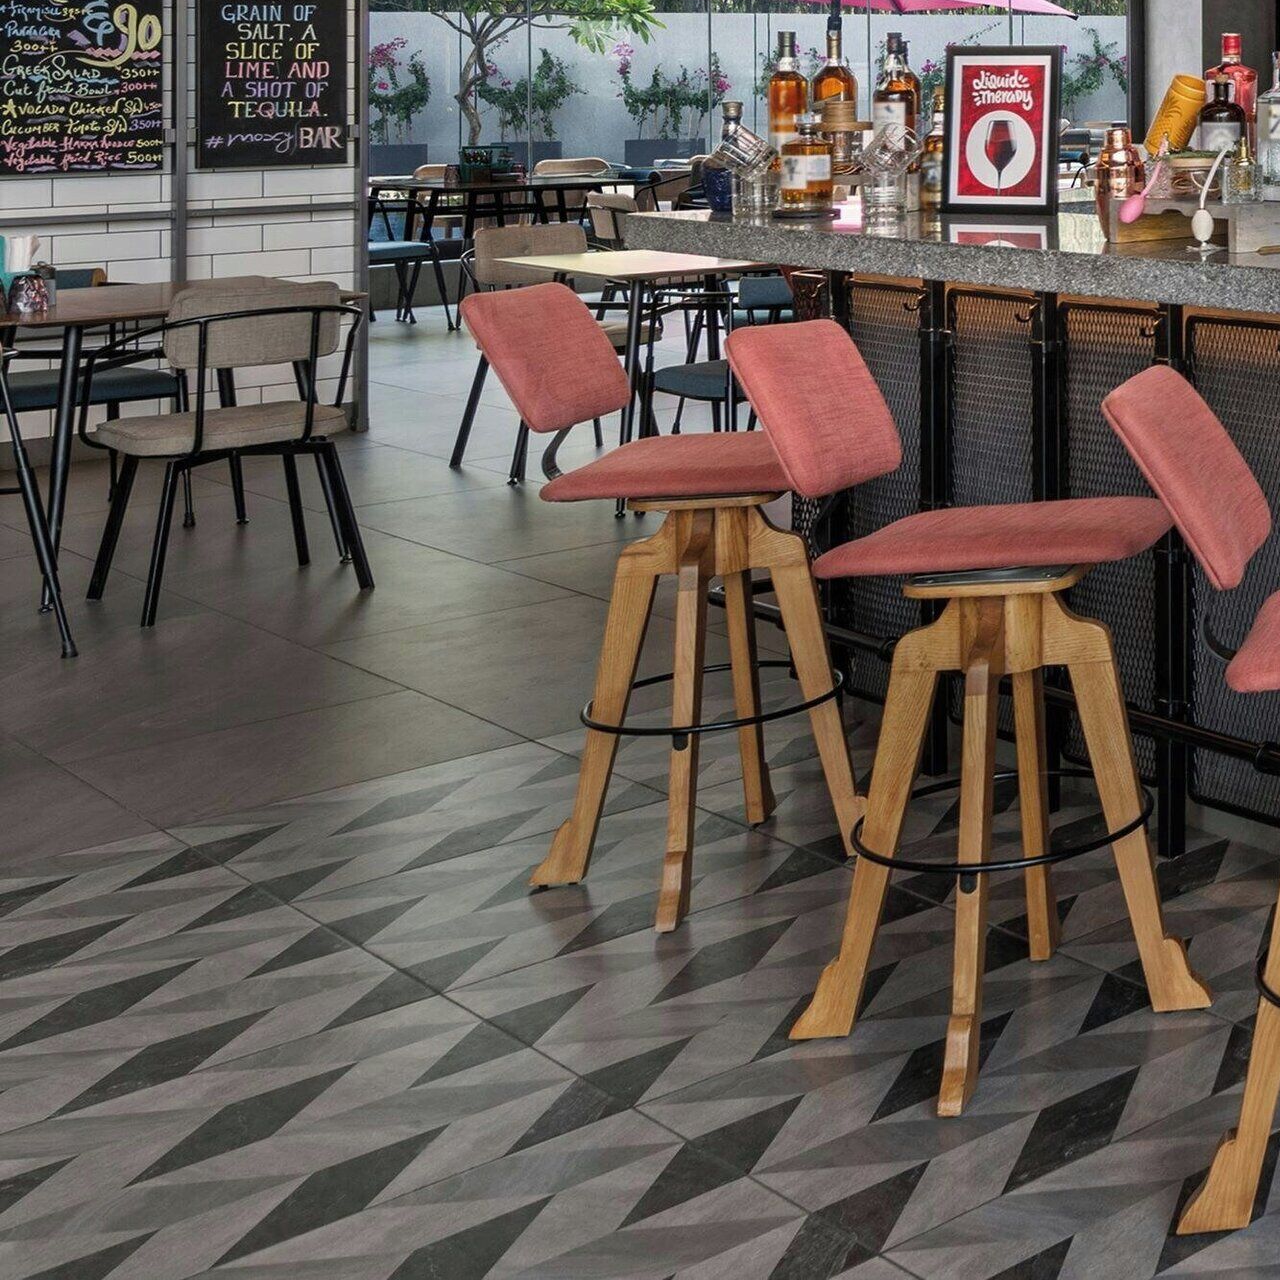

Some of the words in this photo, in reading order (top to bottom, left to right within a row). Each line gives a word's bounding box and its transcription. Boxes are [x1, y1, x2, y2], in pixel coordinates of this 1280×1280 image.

[221, 4, 282, 24] GRAIN
[293, 4, 317, 21] OF
[301, 24, 318, 40] A
[225, 42, 283, 60] SLICE
[295, 42, 321, 60] OF
[288, 61, 330, 79] AND
[973, 69, 1025, 90] Liquid
[221, 81, 234, 98] A
[245, 81, 297, 98] SHOT
[305, 81, 329, 98] OF
[227, 101, 328, 119] TEQUILA.
[299, 125, 344, 150] BAR
